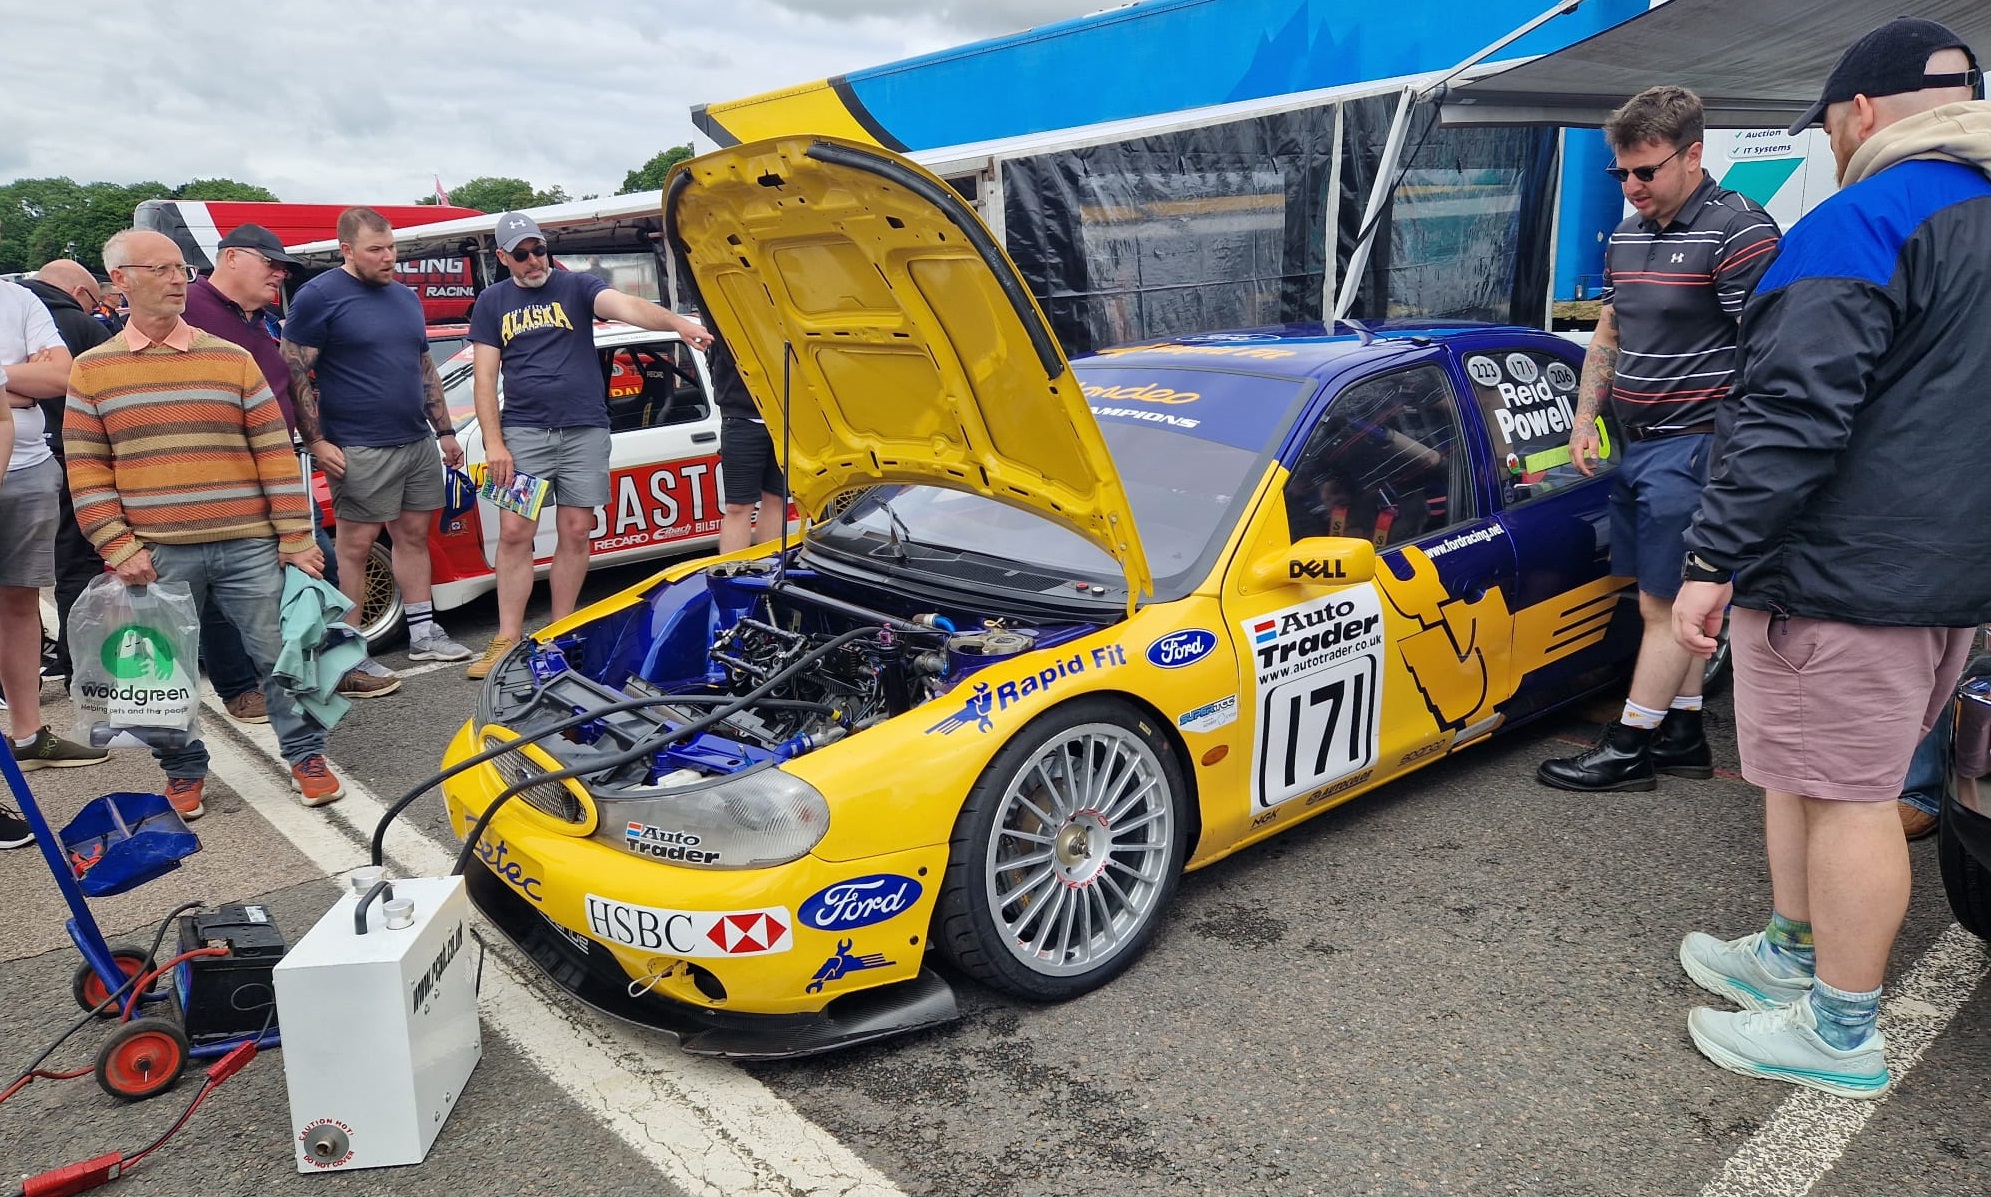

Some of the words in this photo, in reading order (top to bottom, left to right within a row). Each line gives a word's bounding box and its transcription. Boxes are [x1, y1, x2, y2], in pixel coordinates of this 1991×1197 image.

[1745, 129, 1781, 139] Auction
[1743, 146, 1753, 154] IT
[1754, 144, 1791, 155] Systems
[501, 301, 574, 347] ALASKA
[1472, 362, 1497, 378] 223
[1511, 360, 1532, 377] 171
[1550, 368, 1573, 384] 206
[1079, 381, 1201, 405] ondeo
[1497, 375, 1554, 408] Reid
[1090, 406, 1201, 429] AMPIONS
[1494, 395, 1575, 444] Powell
[594, 533, 650, 551] RECARO
[695, 520, 724, 533] BILST
[1423, 522, 1505, 558] www.fordracing.net
[1289, 559, 1347, 579] DELL
[1279, 600, 1355, 637] Auto
[1160, 633, 1205, 664] Ford
[1257, 613, 1379, 669] Trader
[1258, 634, 1382, 685] www.autotrader.co.uk
[996, 653, 1085, 712] Rapid
[1094, 643, 1127, 669] Fit
[81, 684, 190, 706] woodgreen
[127, 707, 144, 715] and
[1283, 672, 1365, 788] 171
[1250, 808, 1281, 829] NGK
[641, 826, 701, 846] Auto
[626, 837, 721, 864] Trader
[1080, 860, 1108, 888] RACING
[815, 878, 909, 926] Ford
[587, 897, 697, 953] HSBC
[298, 1118, 333, 1141] CAUTION
[335, 1120, 355, 1136] HOT!
[303, 1154, 314, 1164] DO
[314, 1160, 331, 1168] NOT
[332, 1150, 354, 1168] COVER
